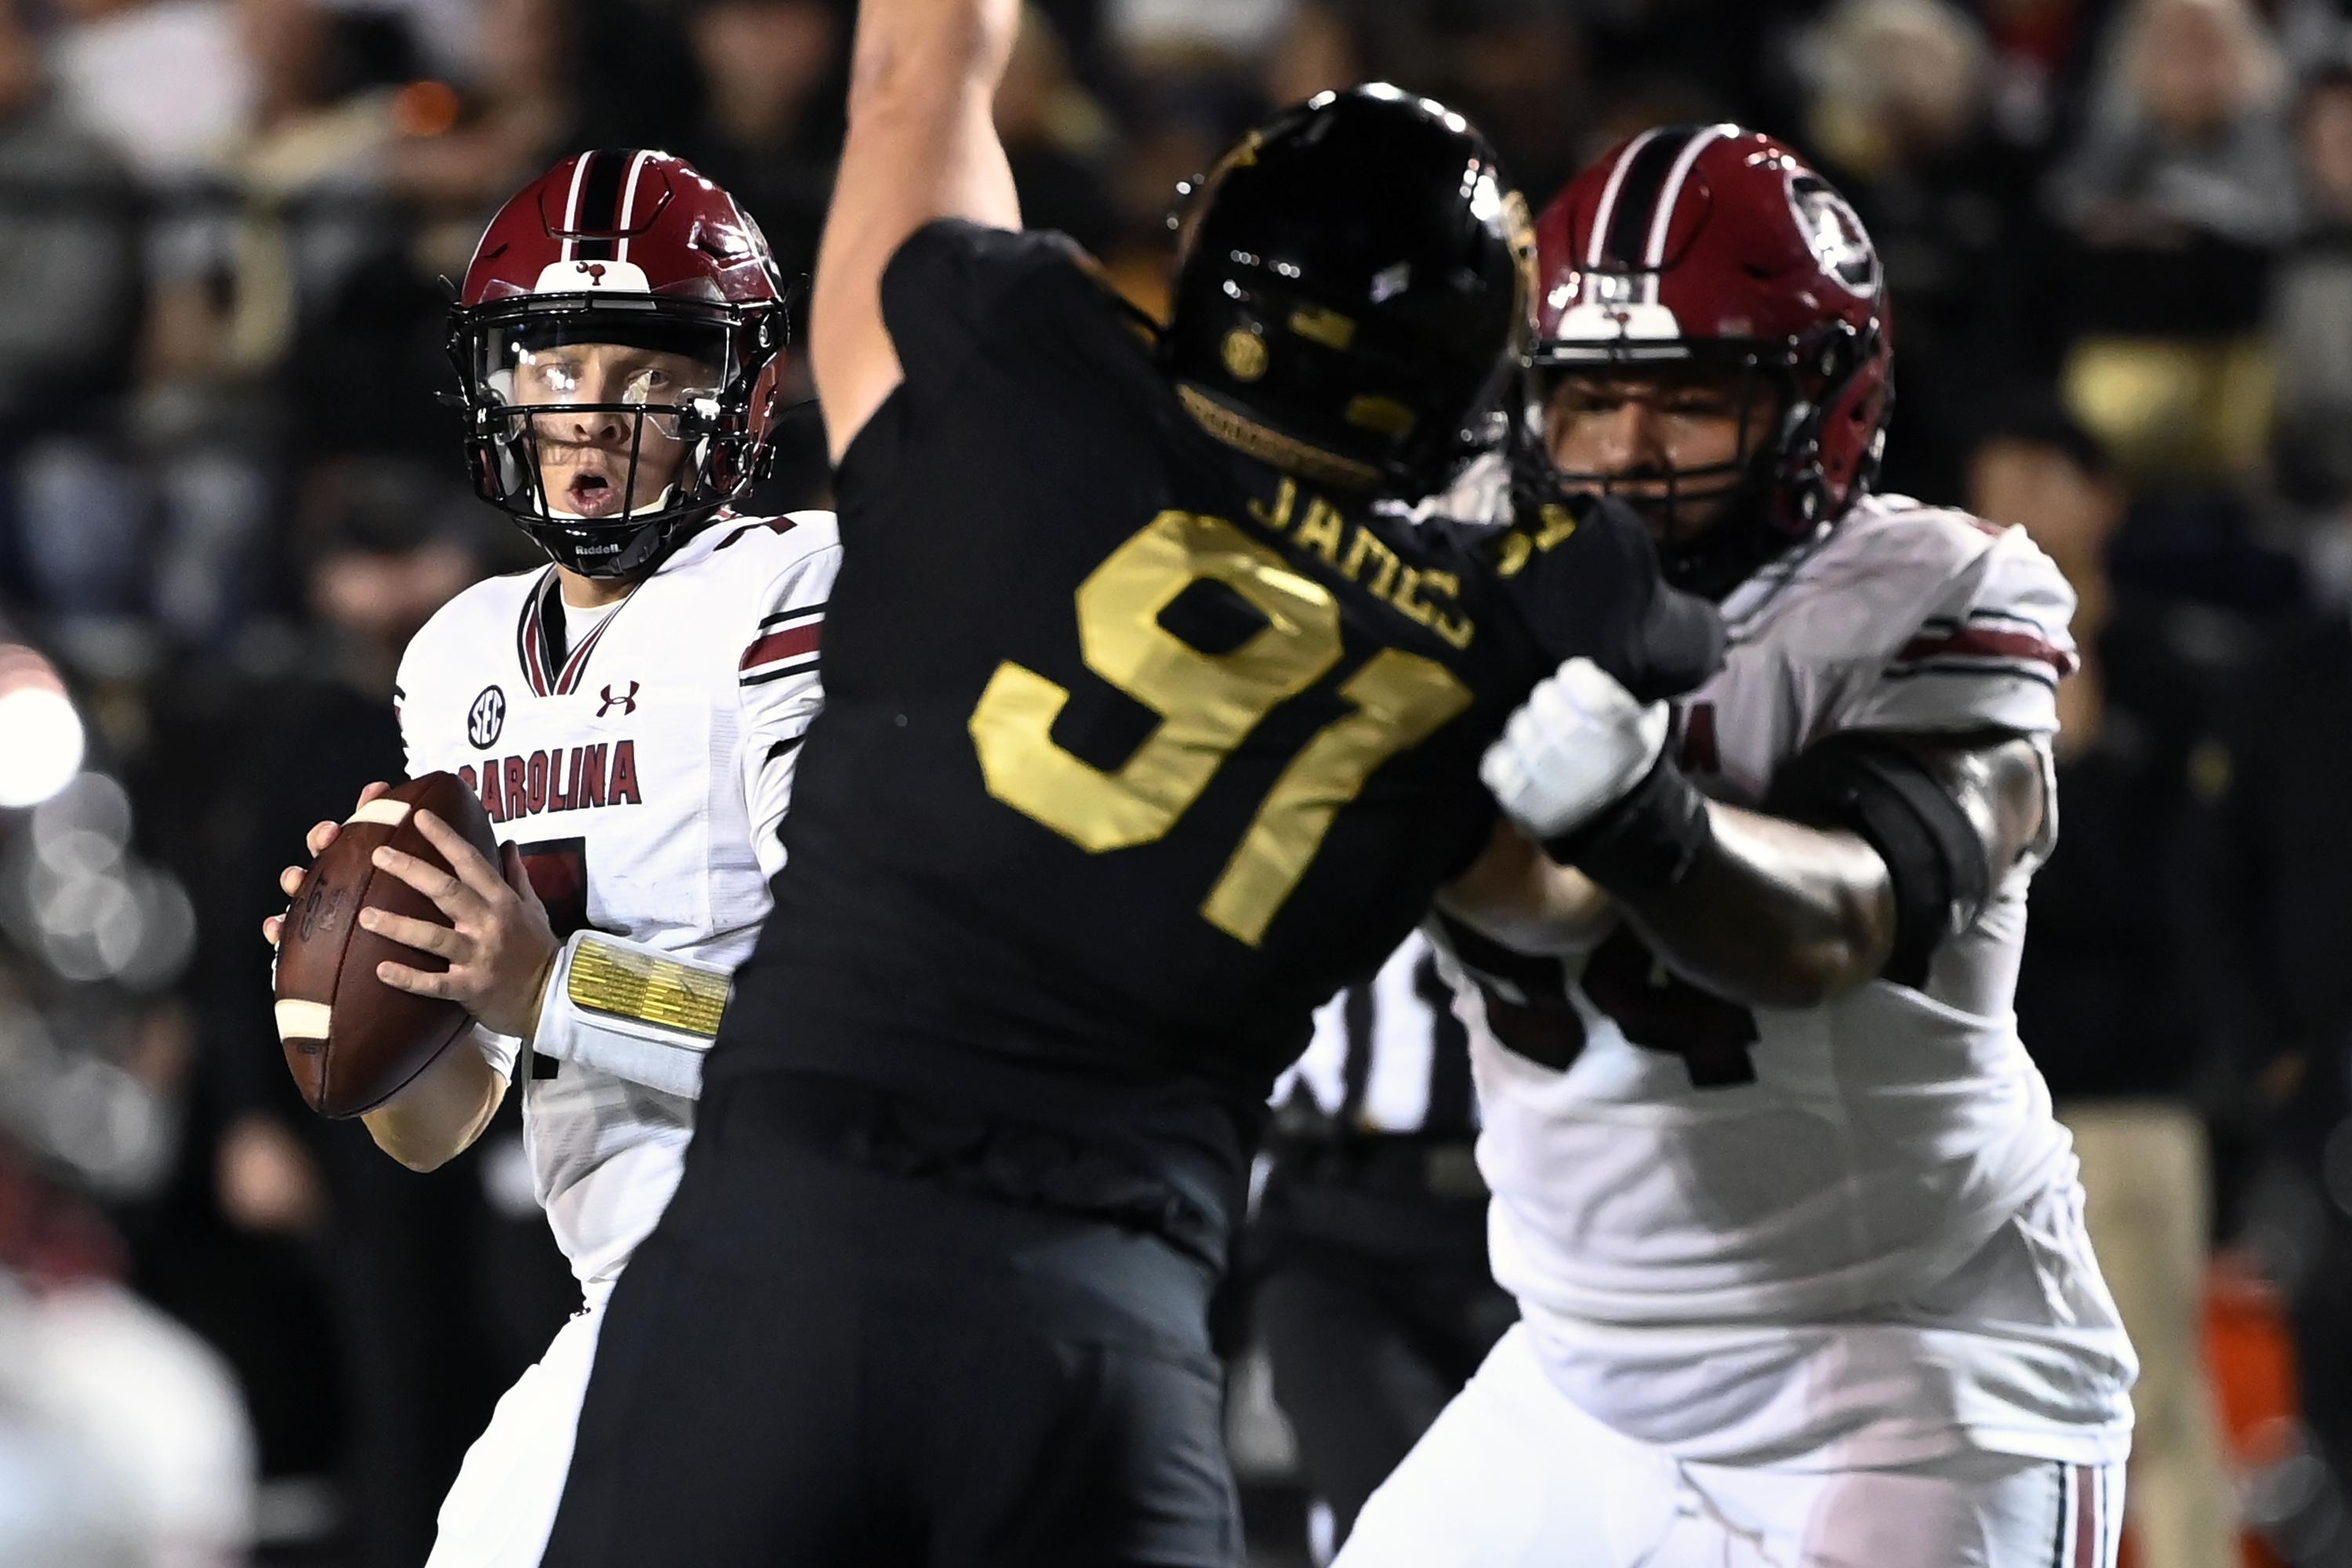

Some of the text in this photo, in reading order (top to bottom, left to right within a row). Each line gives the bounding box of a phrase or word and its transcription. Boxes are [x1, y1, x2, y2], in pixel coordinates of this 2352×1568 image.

[1247, 477, 1475, 649] JAMES
[469, 688, 504, 746] SEC
[969, 509, 1475, 946] 91
